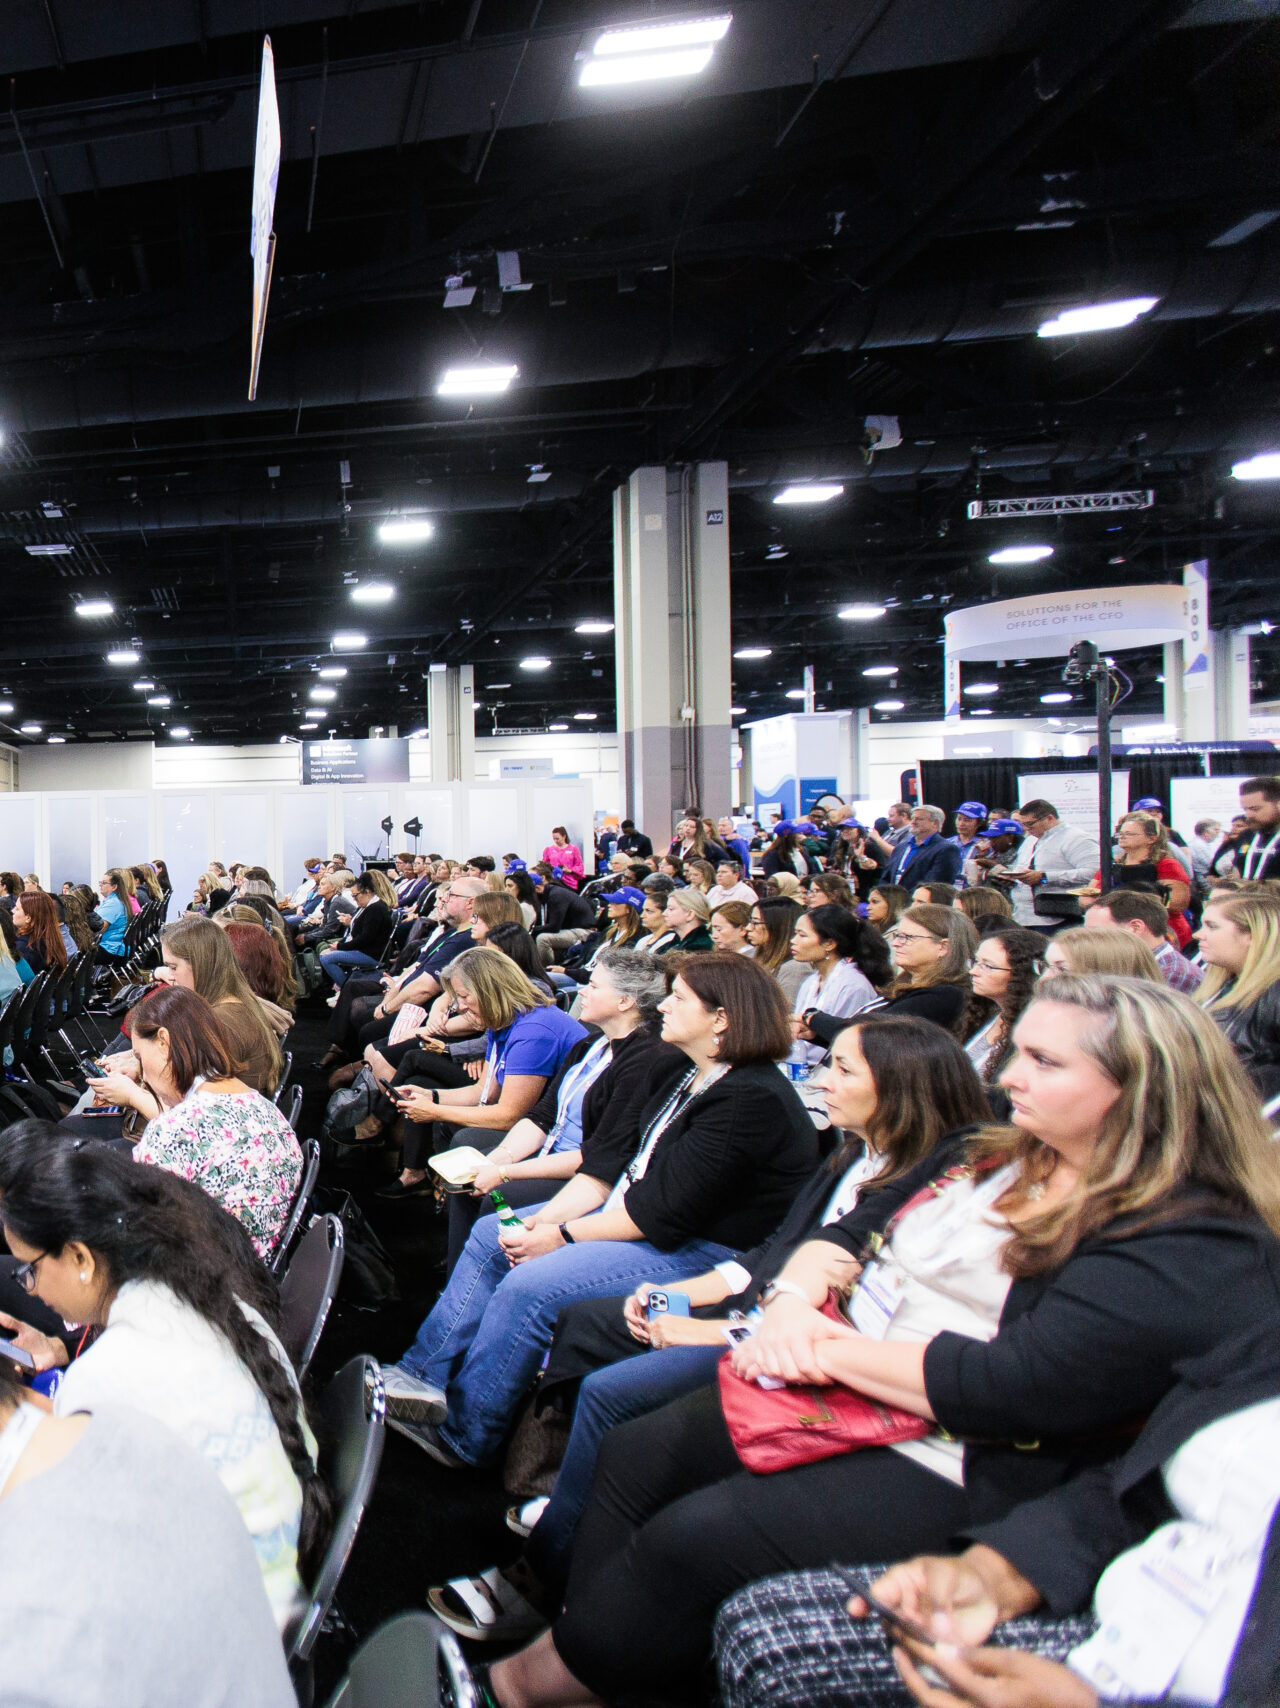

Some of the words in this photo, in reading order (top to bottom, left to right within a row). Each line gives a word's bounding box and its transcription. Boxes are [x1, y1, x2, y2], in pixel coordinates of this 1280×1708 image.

[1006, 603, 1071, 619] SOLUTIONS
[1075, 601, 1098, 611] FOR
[1102, 599, 1123, 608] THE
[1006, 618, 1049, 630] OFFICE
[1052, 615, 1070, 625] OF
[1072, 613, 1096, 623] THE
[1098, 611, 1124, 621] CFO
